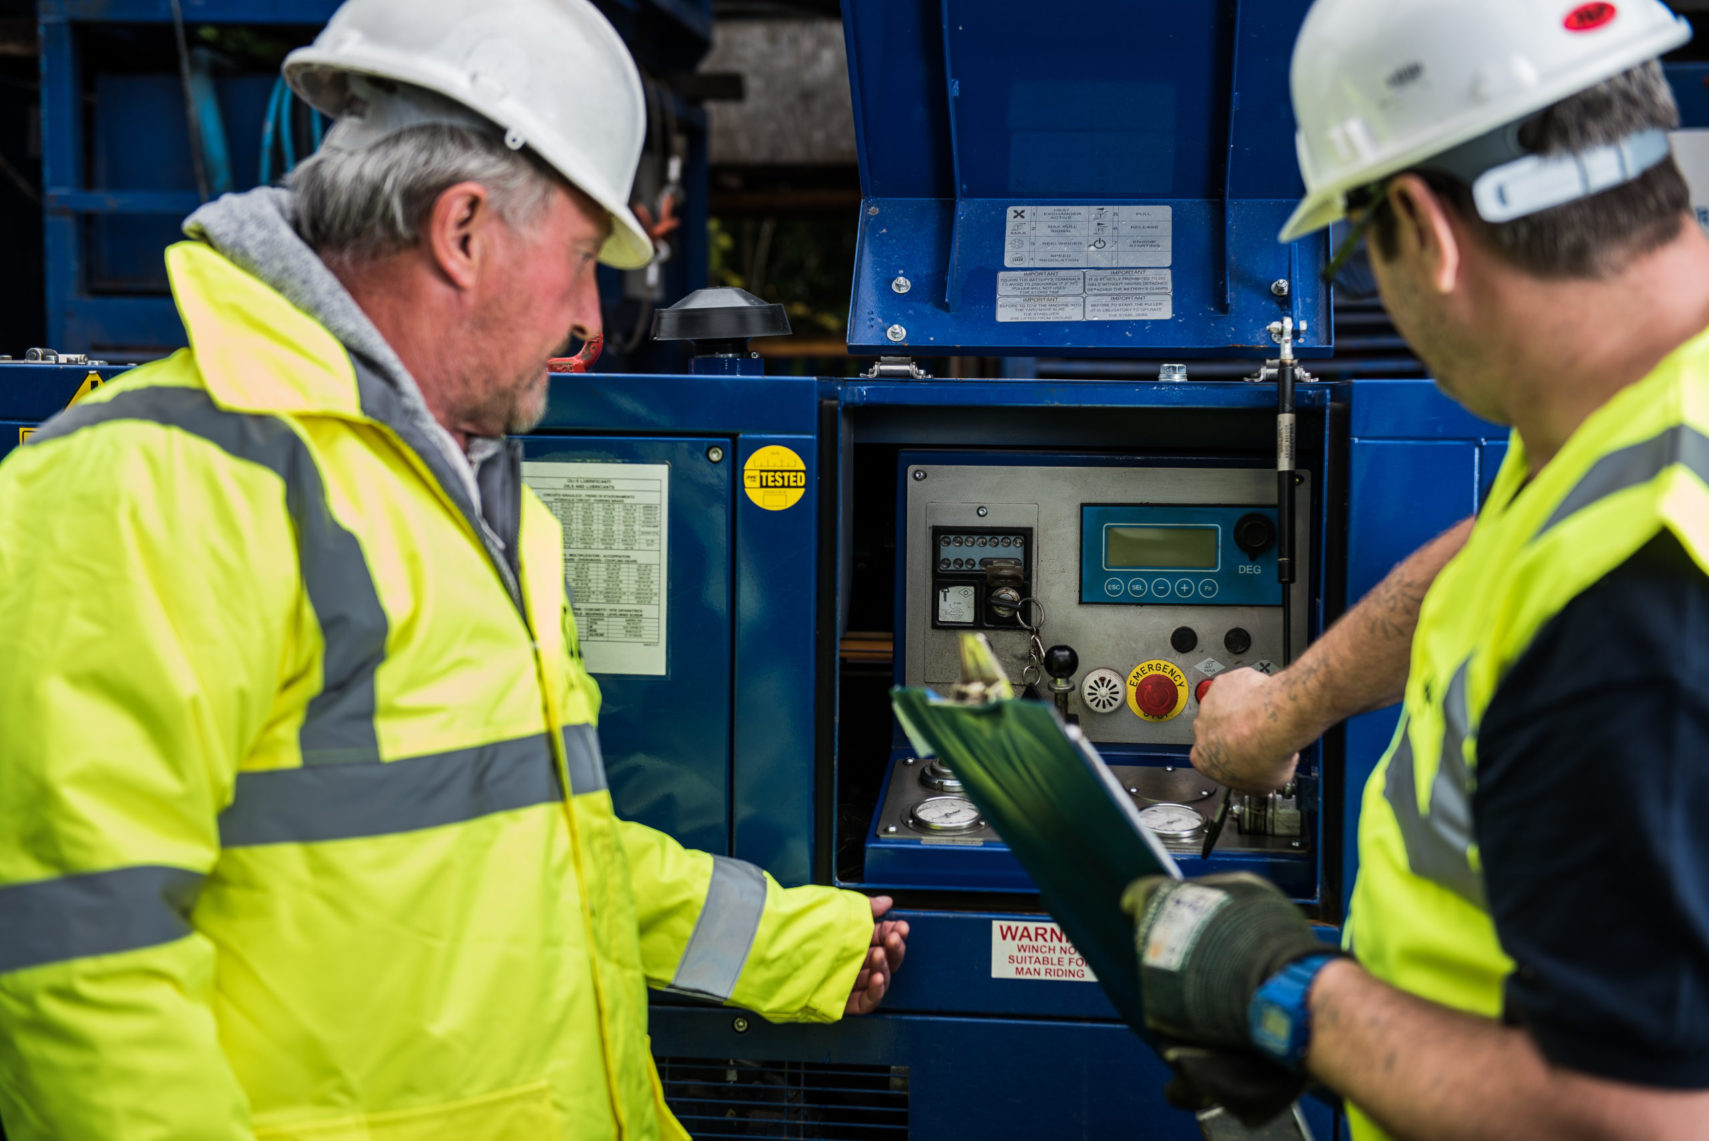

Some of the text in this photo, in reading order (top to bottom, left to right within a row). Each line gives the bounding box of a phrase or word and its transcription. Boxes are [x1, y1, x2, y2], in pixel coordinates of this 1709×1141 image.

[760, 472, 806, 486] TESTED
[1238, 565, 1262, 574] DEG
[1129, 663, 1186, 688] EMERGENCY
[999, 924, 1070, 944] WARN
[1017, 944, 1077, 956] WINCH NO
[1008, 954, 1088, 968] SUITABLE FO
[1015, 966, 1085, 978] MAN RIDING
